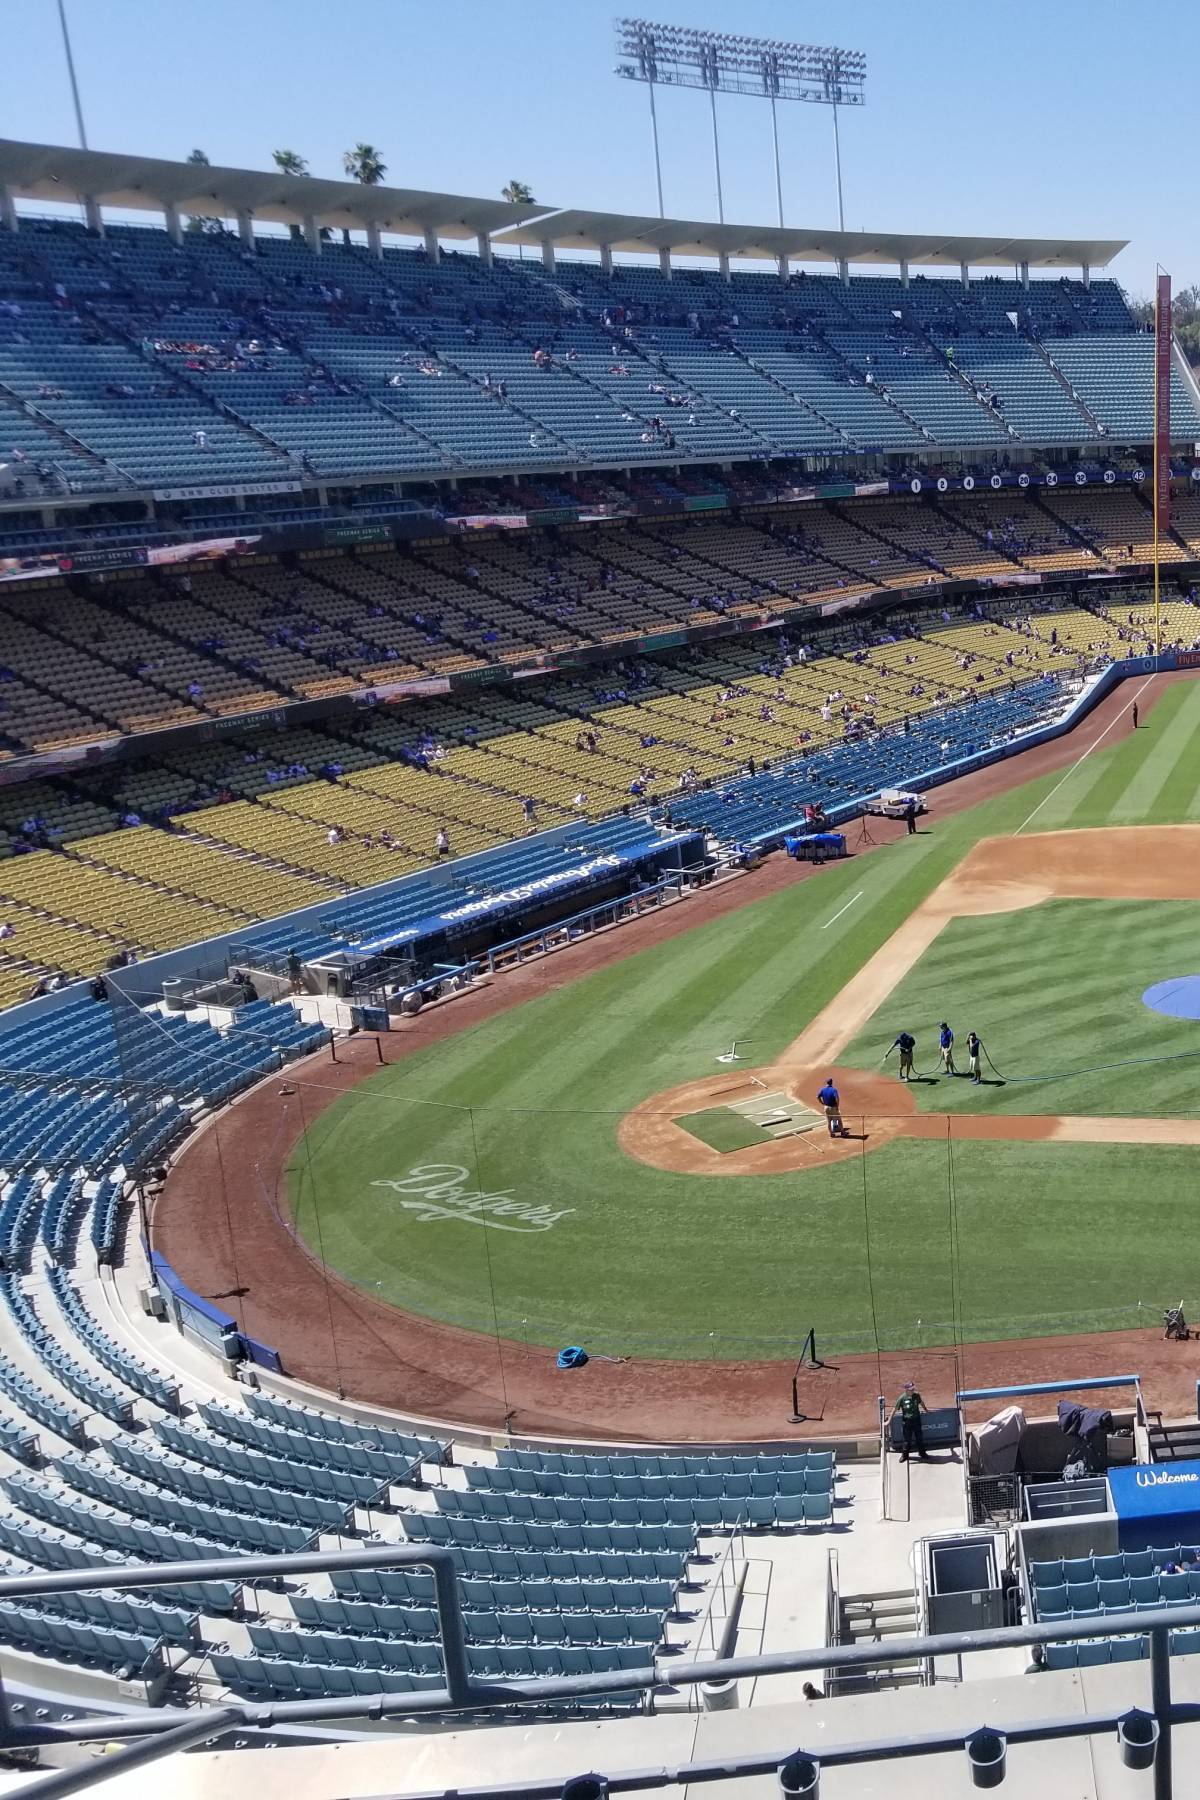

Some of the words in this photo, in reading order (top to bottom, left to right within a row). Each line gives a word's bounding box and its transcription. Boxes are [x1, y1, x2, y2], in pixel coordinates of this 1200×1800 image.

[1047, 475, 1057, 483] 24
[1105, 473, 1114, 481] 39
[1134, 471, 1143, 480] 42
[1178, 655, 1191, 665] Fly
[369, 1164, 577, 1232] Dodgers
[1136, 1470, 1200, 1488] Welcome
